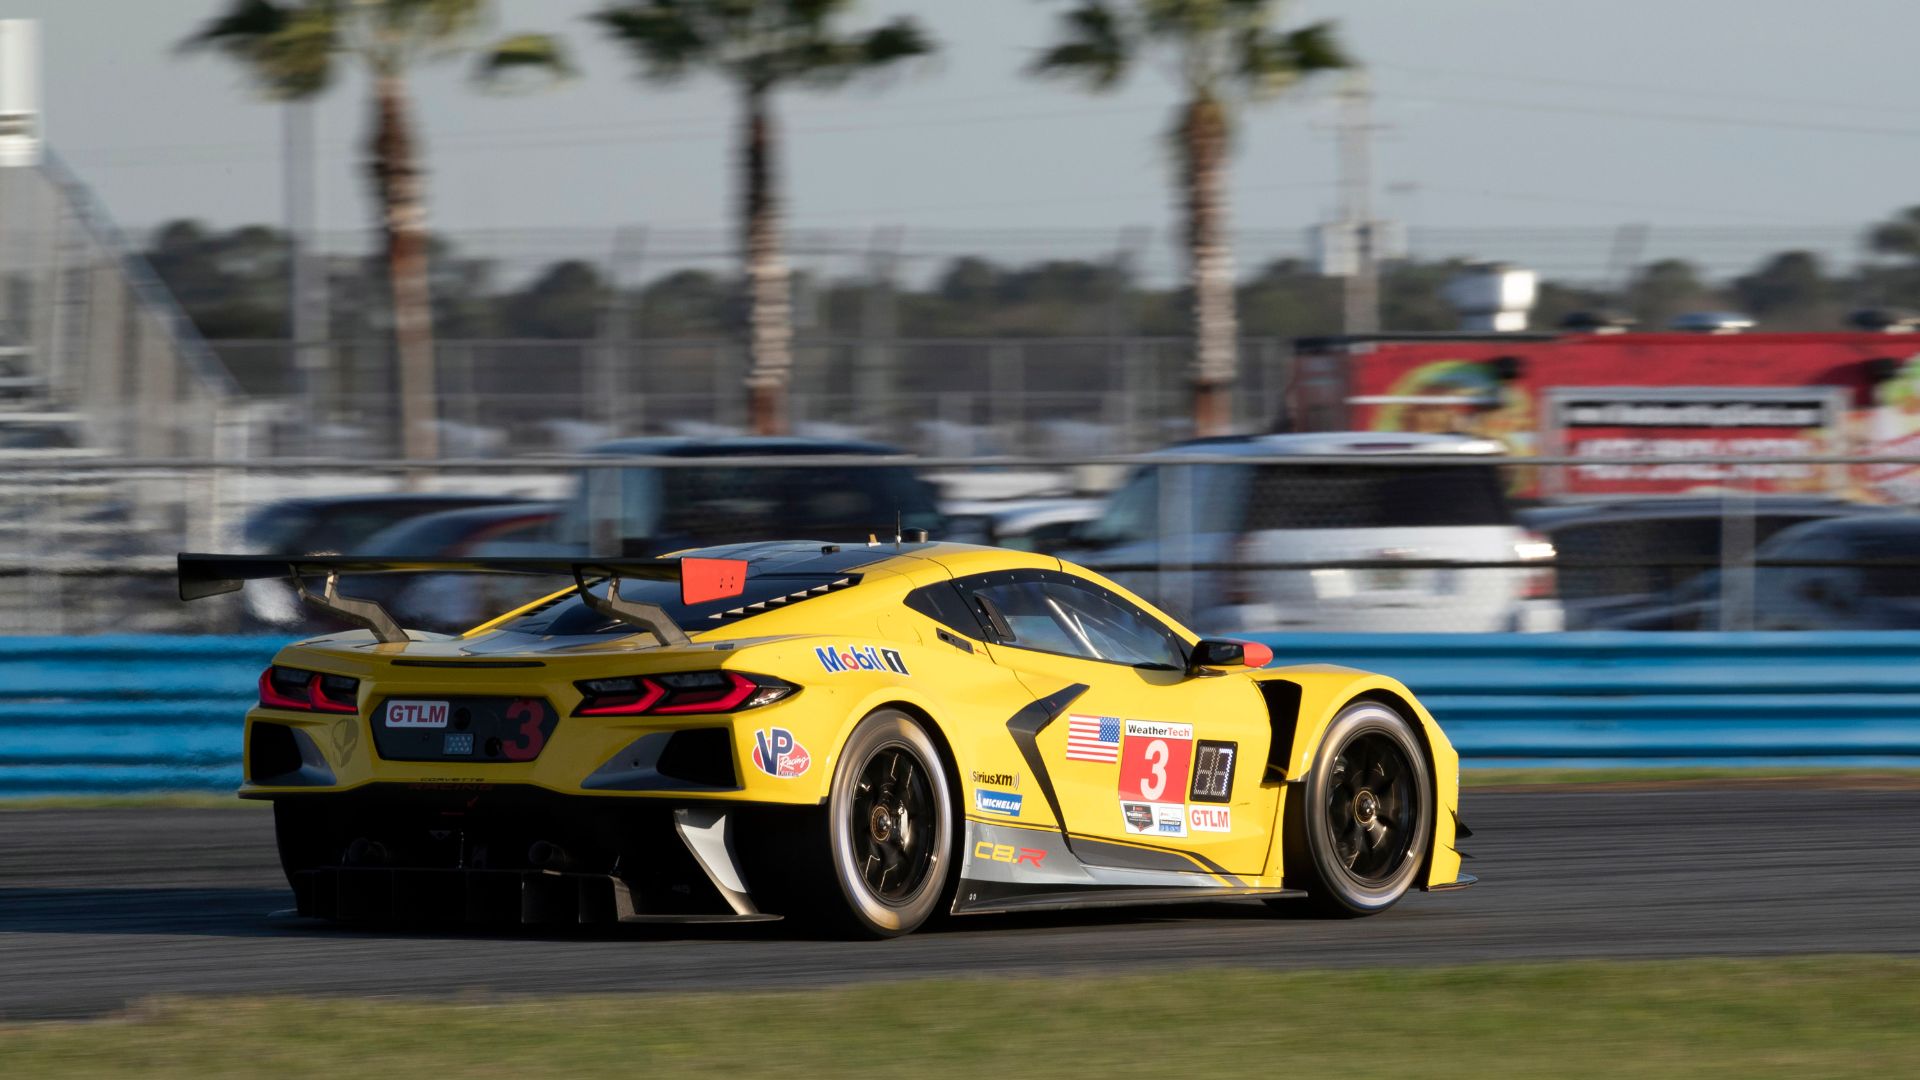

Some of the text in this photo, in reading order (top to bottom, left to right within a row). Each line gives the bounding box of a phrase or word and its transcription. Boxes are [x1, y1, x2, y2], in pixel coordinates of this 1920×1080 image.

[815, 646, 906, 674] Mobil 1
[389, 705, 446, 723] GTLM
[503, 699, 544, 762] 3
[1128, 724, 1190, 737] WeatherTech
[756, 729, 794, 776] VP
[780, 755, 809, 771] Racing
[1140, 739, 1169, 800] 3
[982, 797, 1021, 811] MICHELIN
[1191, 809, 1229, 828] GTLM
[975, 841, 1048, 868] C8.R
